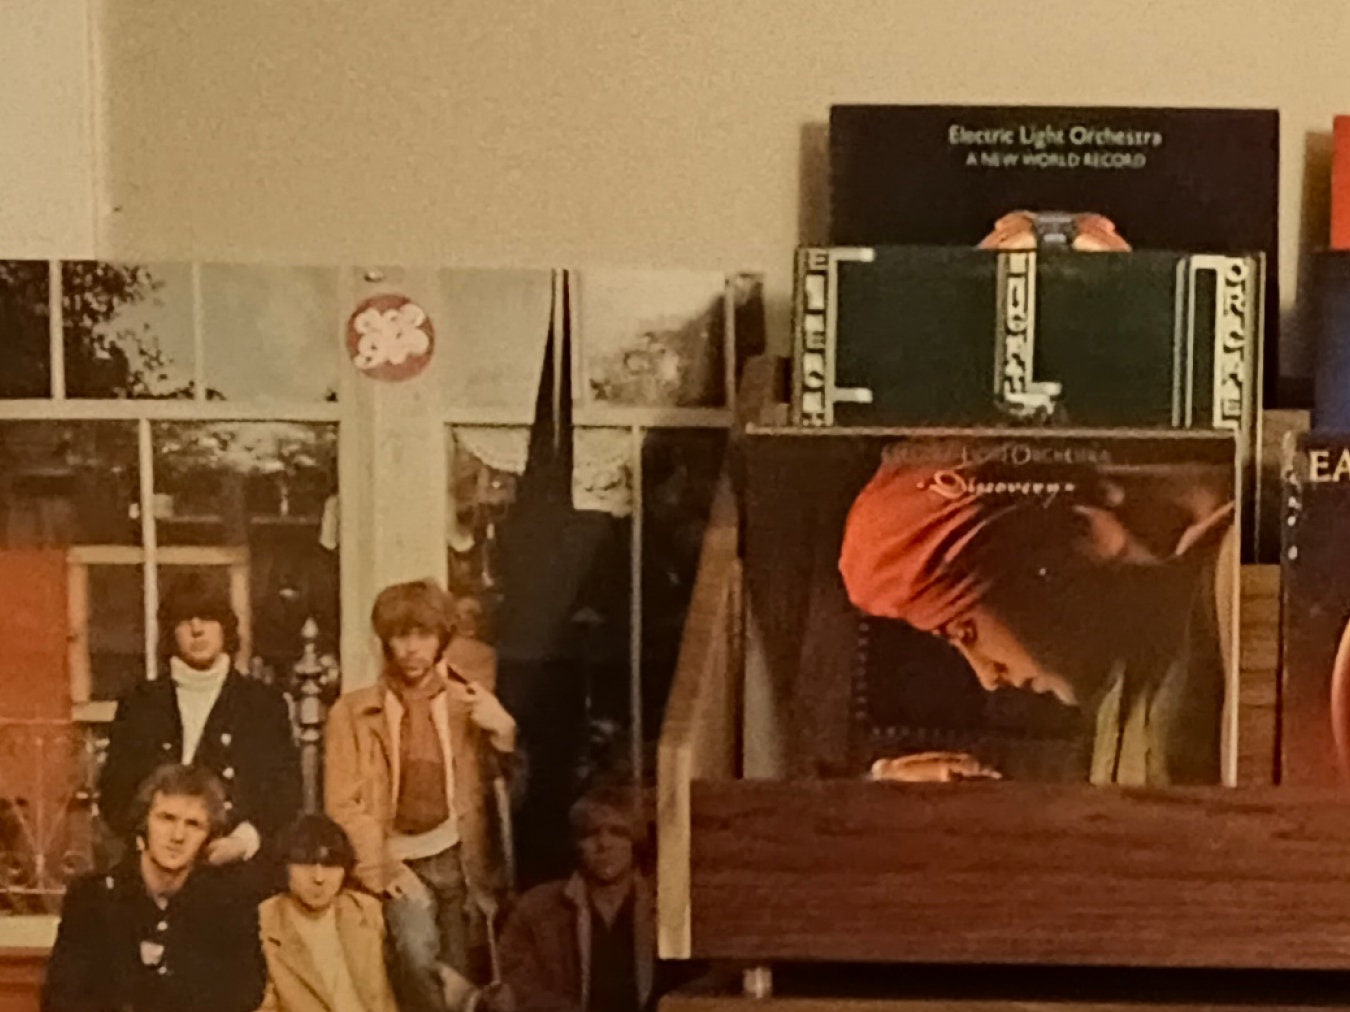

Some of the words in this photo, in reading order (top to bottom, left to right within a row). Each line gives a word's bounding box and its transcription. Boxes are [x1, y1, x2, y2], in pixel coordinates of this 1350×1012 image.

[948, 124, 1015, 145] Electric
[1019, 125, 1065, 149] Light
[1069, 126, 1163, 145] Orchestra
[966, 152, 979, 166] A
[980, 152, 1020, 167] NEW
[1022, 152, 1081, 167] WORLD
[1083, 152, 1147, 168] RECORD
